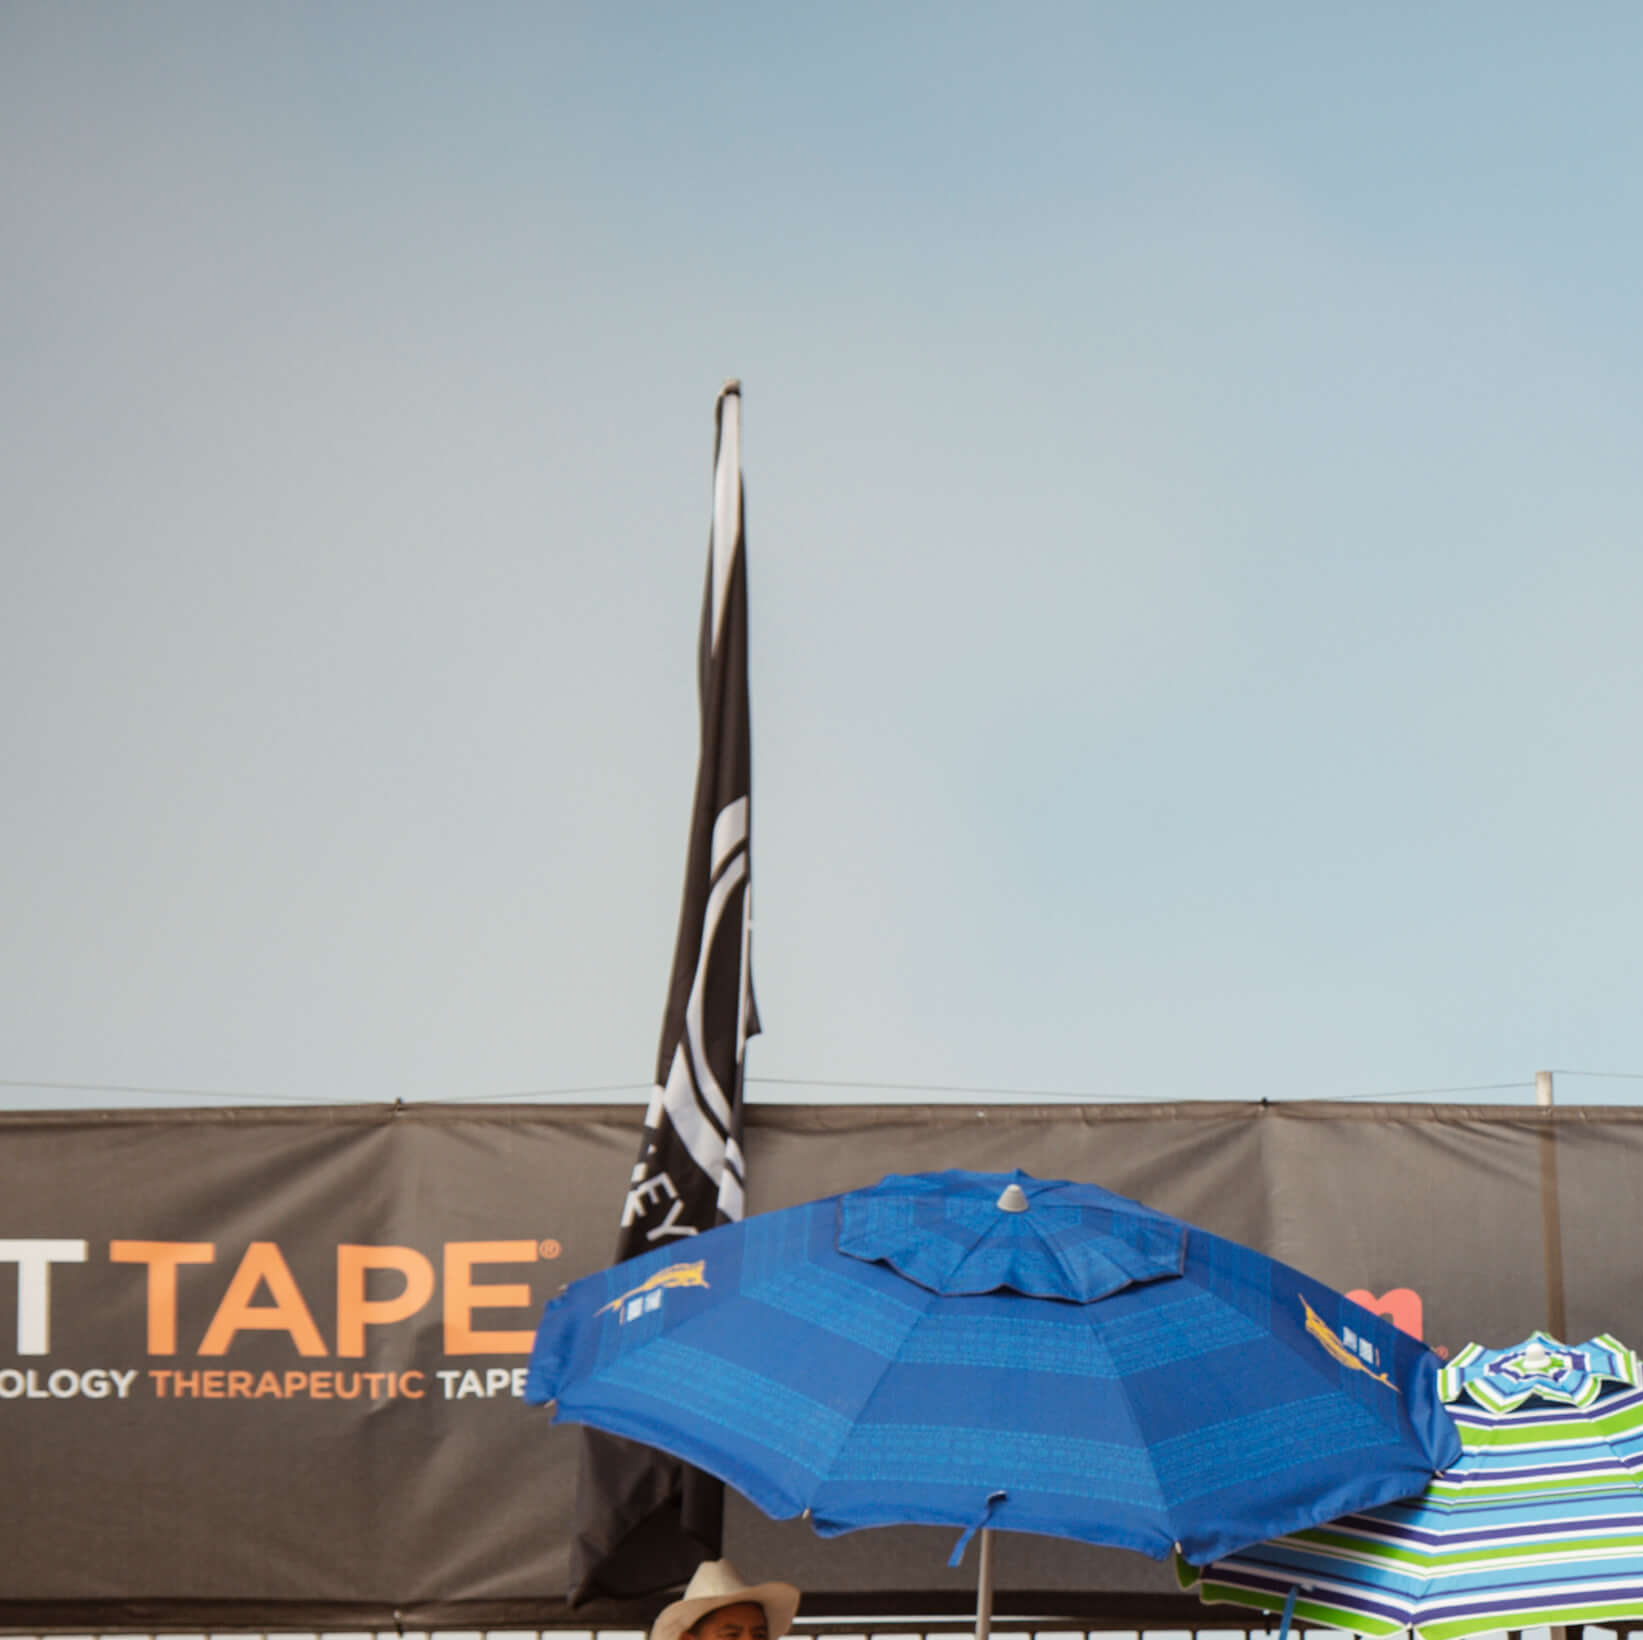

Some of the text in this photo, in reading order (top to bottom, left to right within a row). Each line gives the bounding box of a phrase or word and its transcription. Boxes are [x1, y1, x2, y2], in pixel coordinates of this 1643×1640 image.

[109, 1239, 539, 1358] TAPE
[0, 1368, 530, 1400] OLOGY THERAPEUTIC TAPE
